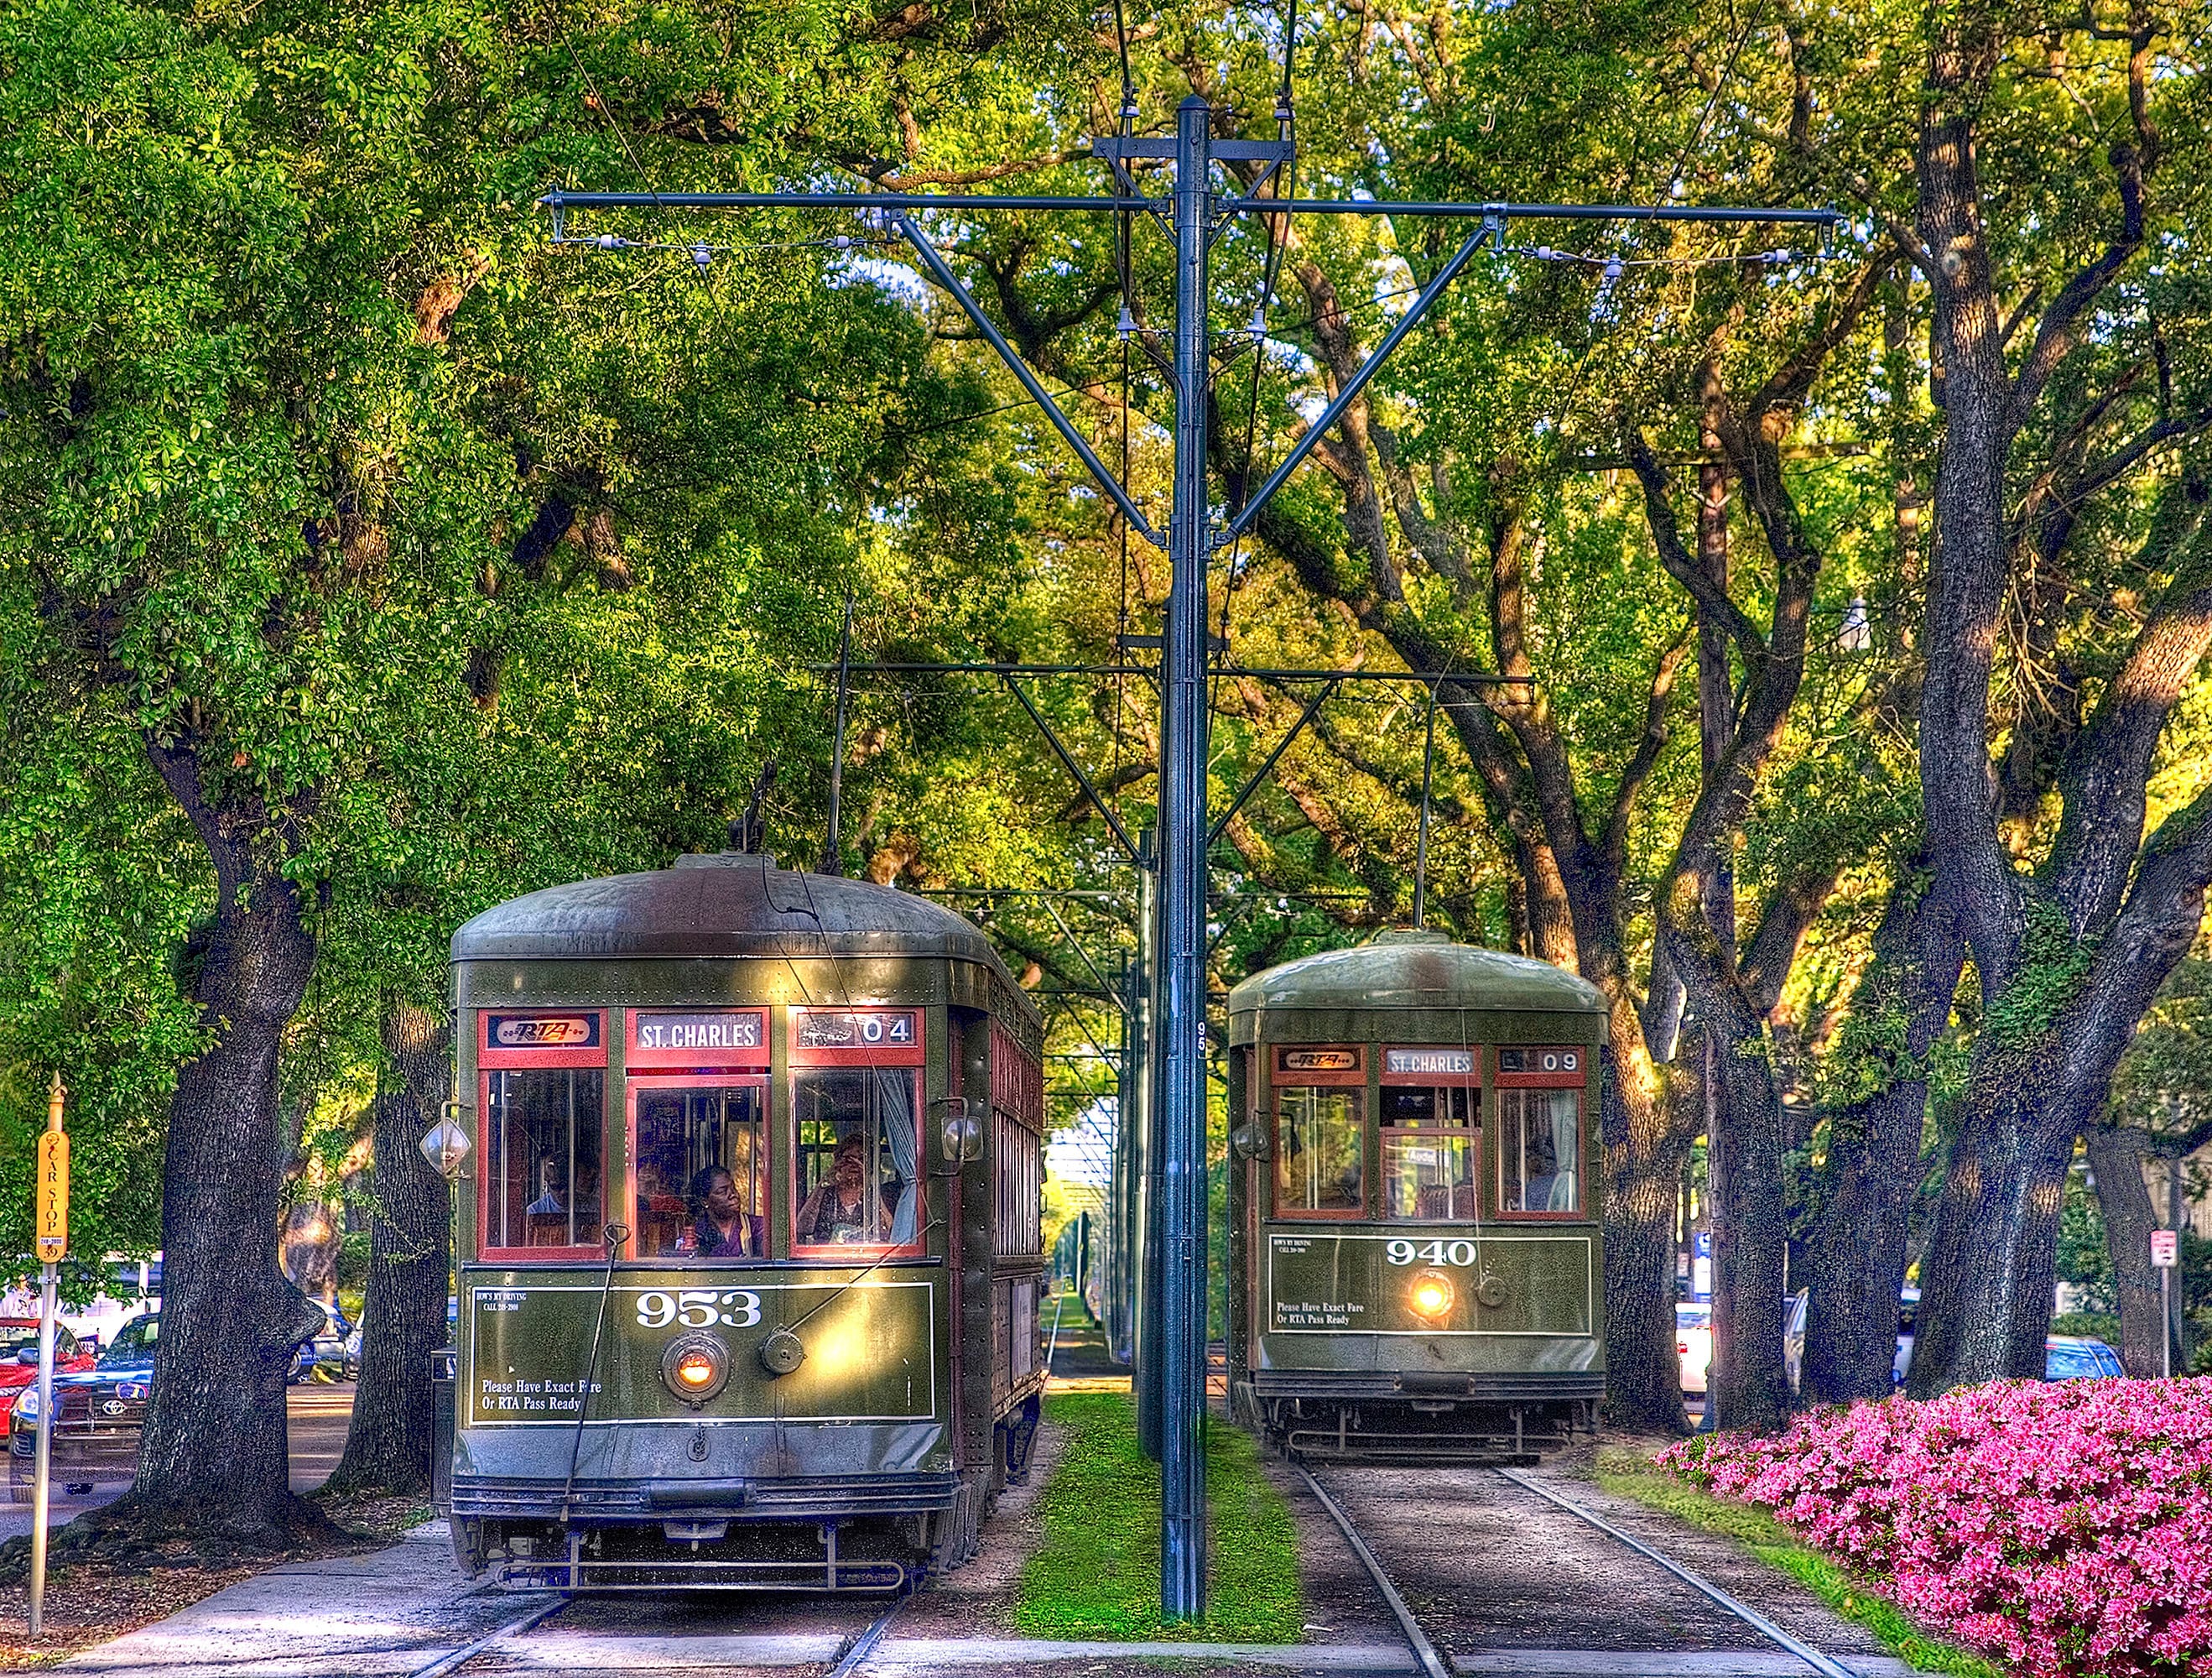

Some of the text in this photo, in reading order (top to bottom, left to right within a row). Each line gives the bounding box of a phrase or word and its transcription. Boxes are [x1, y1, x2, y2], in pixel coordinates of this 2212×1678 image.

[515, 1022, 570, 1041] RTA
[642, 1024, 755, 1048] ST. CHARLES
[862, 1019, 908, 1042] 04
[1197, 1021, 1205, 1051] 95
[1299, 1054, 1340, 1066] RTA
[1391, 1055, 1470, 1072] ST. CHARLES
[1543, 1054, 1577, 1071] 09
[47, 1149, 58, 1183] CAR
[45, 1187, 58, 1232] STOP
[1387, 1240, 1477, 1266] 940
[636, 1290, 762, 1328] 953
[1277, 1301, 1365, 1313] Please Have Exact Fare
[1277, 1314, 1350, 1326] Or RTA Pass Ready
[481, 1379, 602, 1393] Please Have Exact Fre
[481, 1395, 581, 1411] Or RTA Pass Ready
